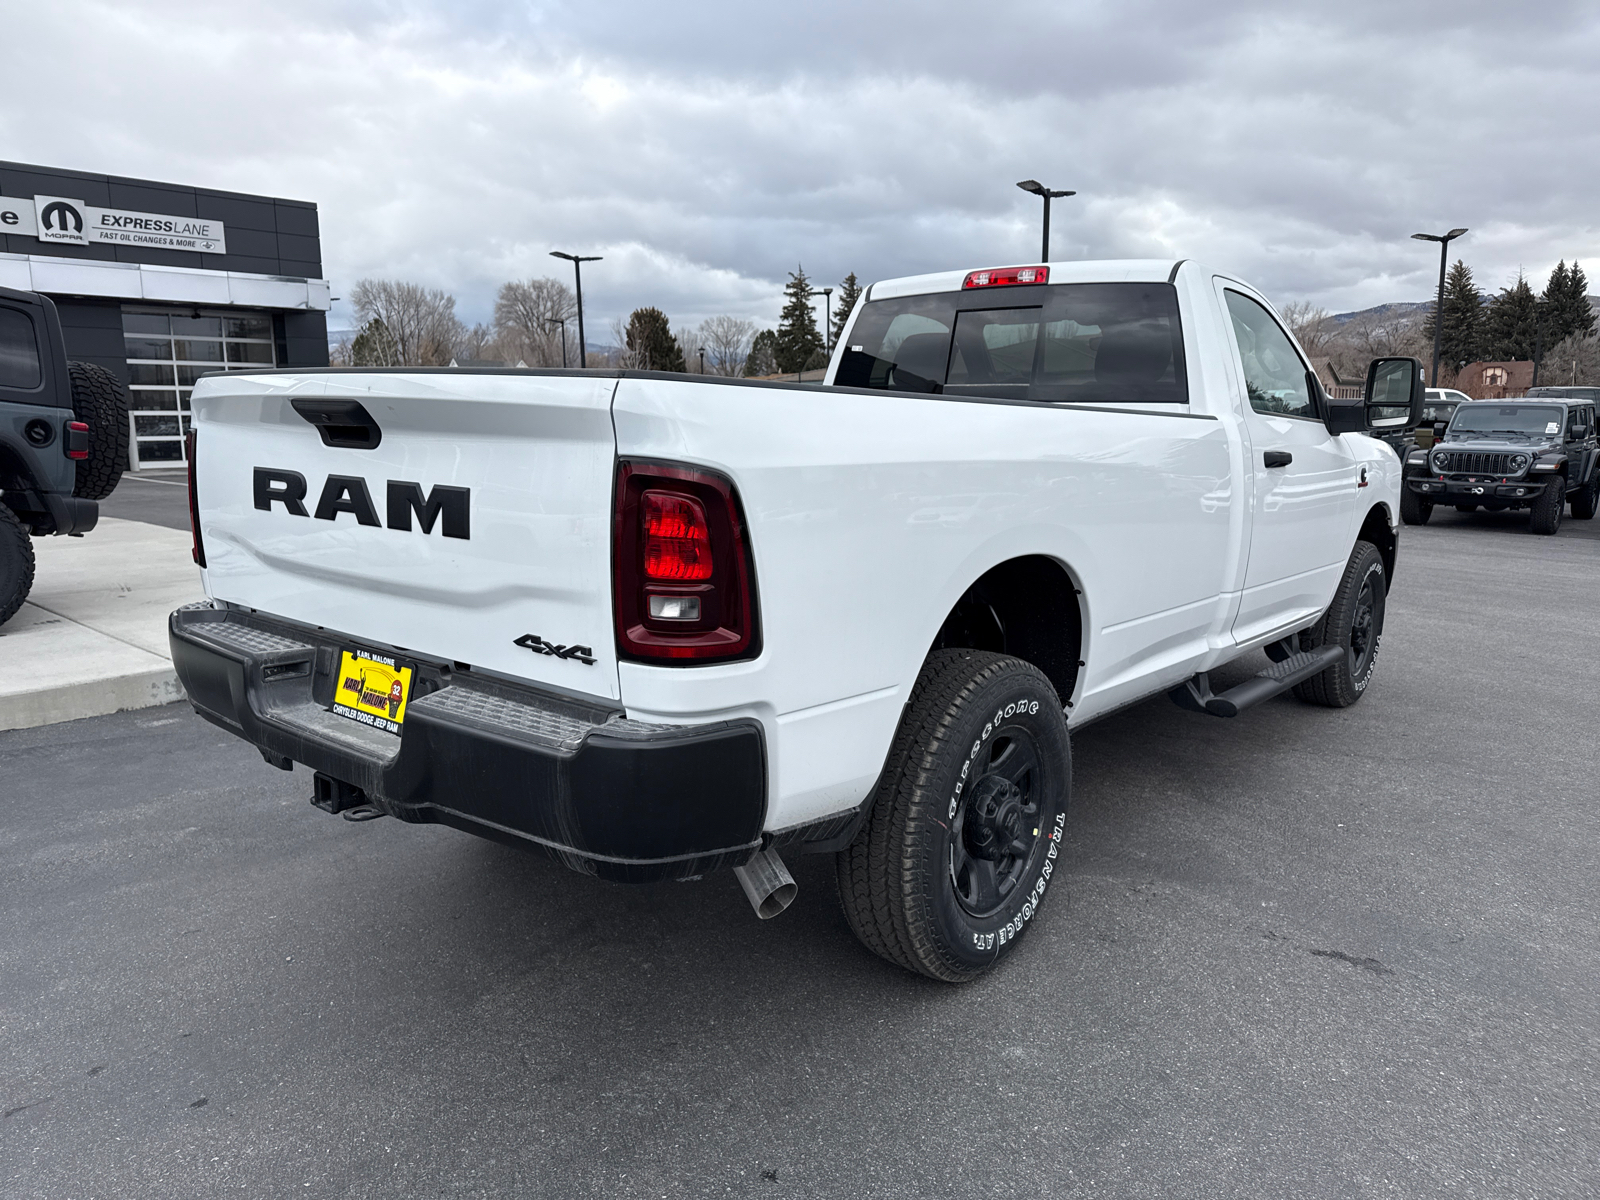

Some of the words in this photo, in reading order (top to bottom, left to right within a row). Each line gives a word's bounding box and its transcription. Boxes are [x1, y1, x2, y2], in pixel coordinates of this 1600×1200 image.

[45, 232, 83, 241] MOPAR
[99, 231, 118, 240] FAST
[120, 233, 132, 242] OIL
[133, 234, 167, 245] CHANGES
[168, 237, 174, 246] &
[176, 238, 196, 248] MORE
[253, 466, 470, 540] RAM
[357, 650, 371, 660] KARL
[372, 654, 395, 666] MALONE
[392, 684, 401, 696] 32
[333, 704, 357, 719] CHRYSLER
[357, 712, 374, 724] DODGE
[374, 717, 387, 729] JEEP
[387, 721, 399, 733] RAM
[999, 811, 1067, 946] TRANSFORCE
